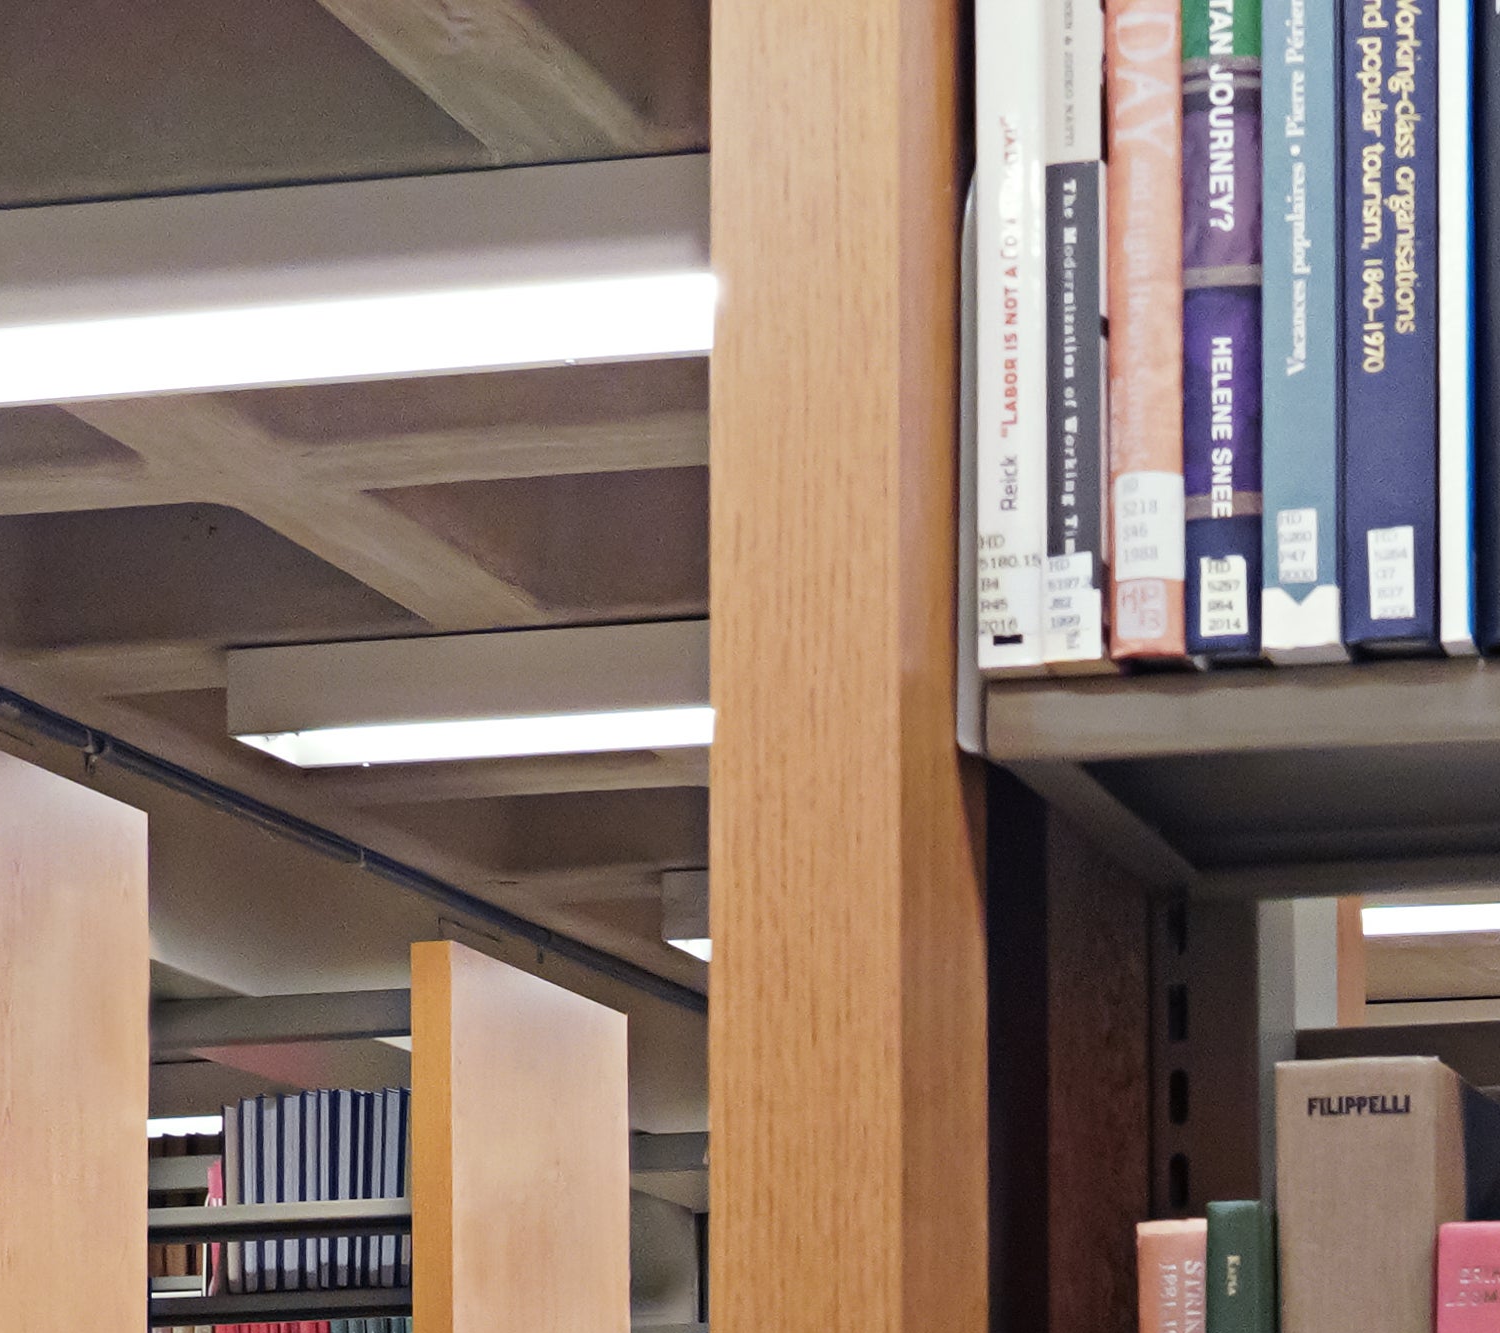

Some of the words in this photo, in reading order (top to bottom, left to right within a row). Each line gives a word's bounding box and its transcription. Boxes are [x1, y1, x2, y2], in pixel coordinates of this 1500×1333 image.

[1356, 36, 1389, 138] popular
[1209, 64, 1235, 232] JOURNEY?
[1361, 142, 1385, 250] tourism,
[1384, 165, 1418, 334] organisations
[1211, 337, 1233, 440] HELENE
[1211, 447, 1233, 518] SNEE
[1307, 1094, 1411, 1117] FILIPPELLI
